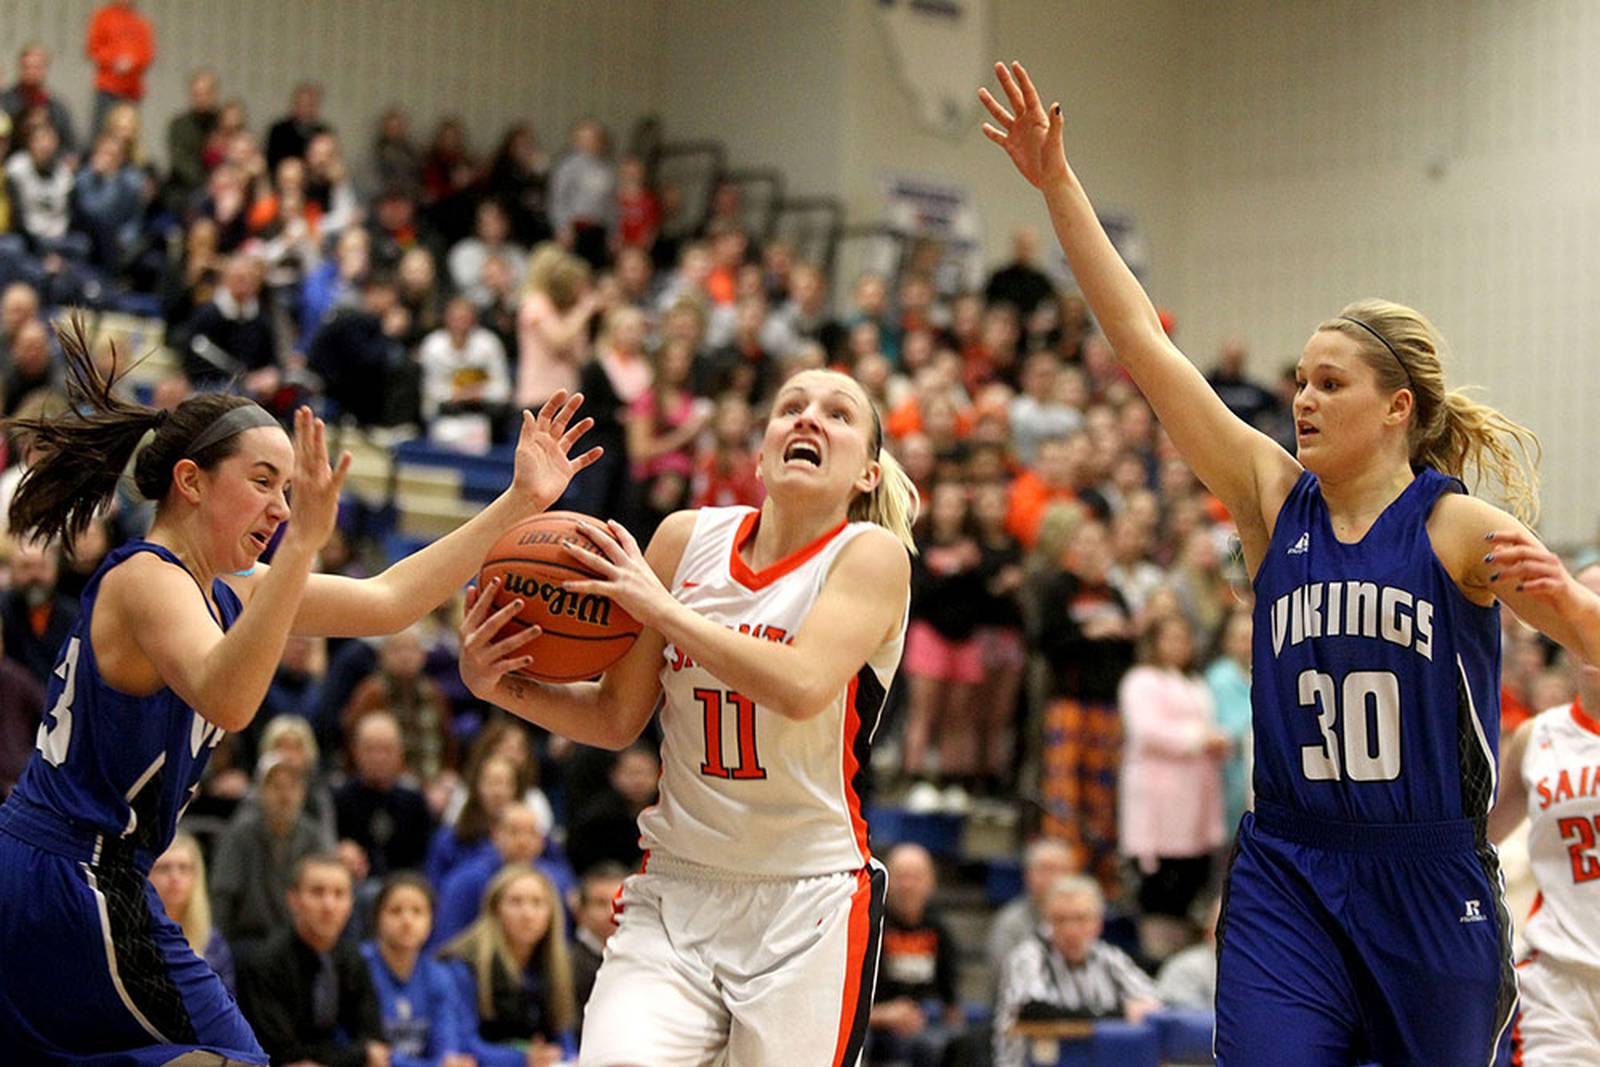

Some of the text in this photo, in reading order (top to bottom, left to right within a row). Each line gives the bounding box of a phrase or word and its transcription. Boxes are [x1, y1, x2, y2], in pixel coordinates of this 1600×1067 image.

[504, 572, 611, 627] Wilson
[1270, 581, 1434, 662] VIKINGS
[693, 687, 767, 780] 11
[1298, 669, 1401, 782] 30
[1557, 815, 1600, 885] 2
